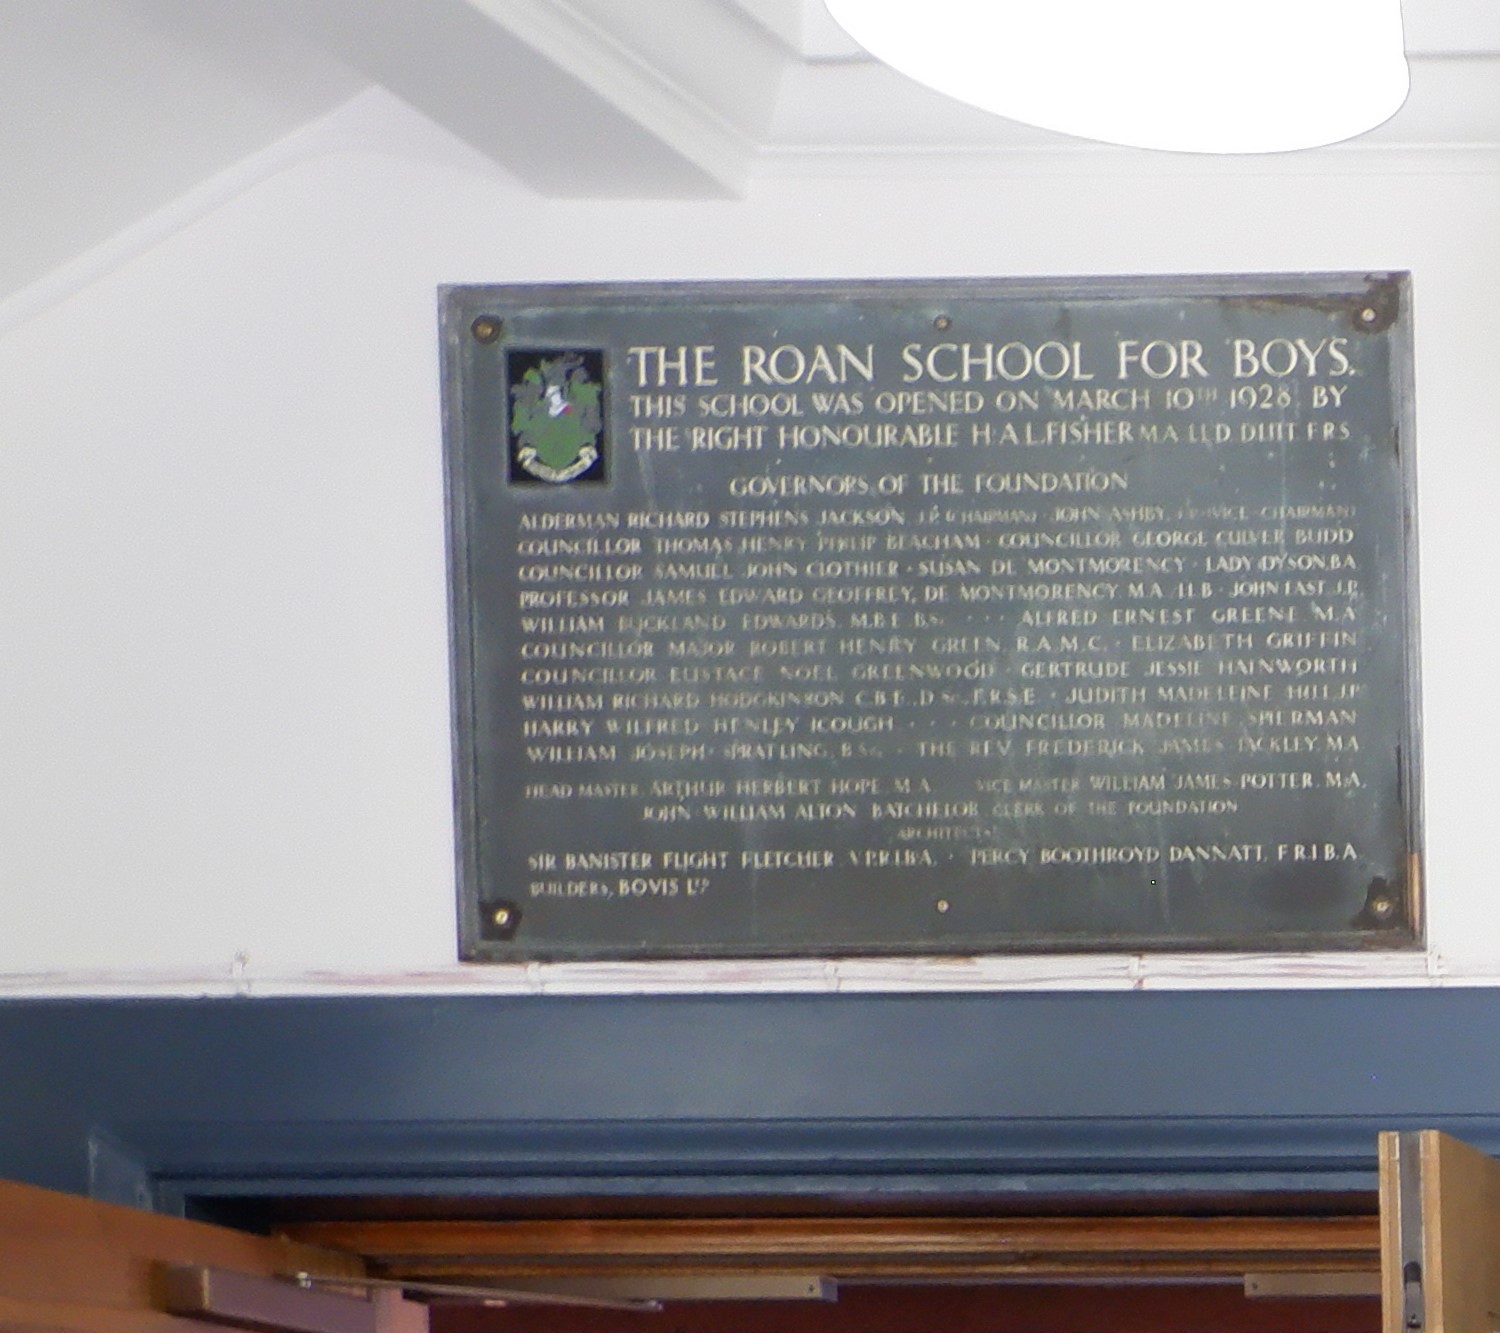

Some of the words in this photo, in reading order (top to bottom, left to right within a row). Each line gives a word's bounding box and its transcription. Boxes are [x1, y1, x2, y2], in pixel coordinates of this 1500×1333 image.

[628, 345, 718, 387] THE
[742, 344, 875, 386] ROAN
[902, 341, 1094, 382] SCHOOL
[1118, 340, 1210, 380] FOR
[629, 395, 686, 418] THIS
[698, 393, 803, 417] SCHOOL
[811, 392, 864, 415] WAS
[874, 390, 985, 414] OPENED
[995, 389, 1039, 411] ON
[1052, 388, 1150, 411] MARCH
[1312, 385, 1348, 409] BY
[629, 427, 679, 451] THE
[692, 425, 765, 451] RIGHT
[778, 423, 958, 449] HONOURABLE
[729, 475, 869, 496] GOVERNORS
[877, 474, 905, 494] OF
[920, 474, 963, 494] THE
[974, 471, 1128, 494] FOUNDATION
[970, 848, 1028, 865] PERCY
[1040, 846, 1160, 864] BOOTHROYD
